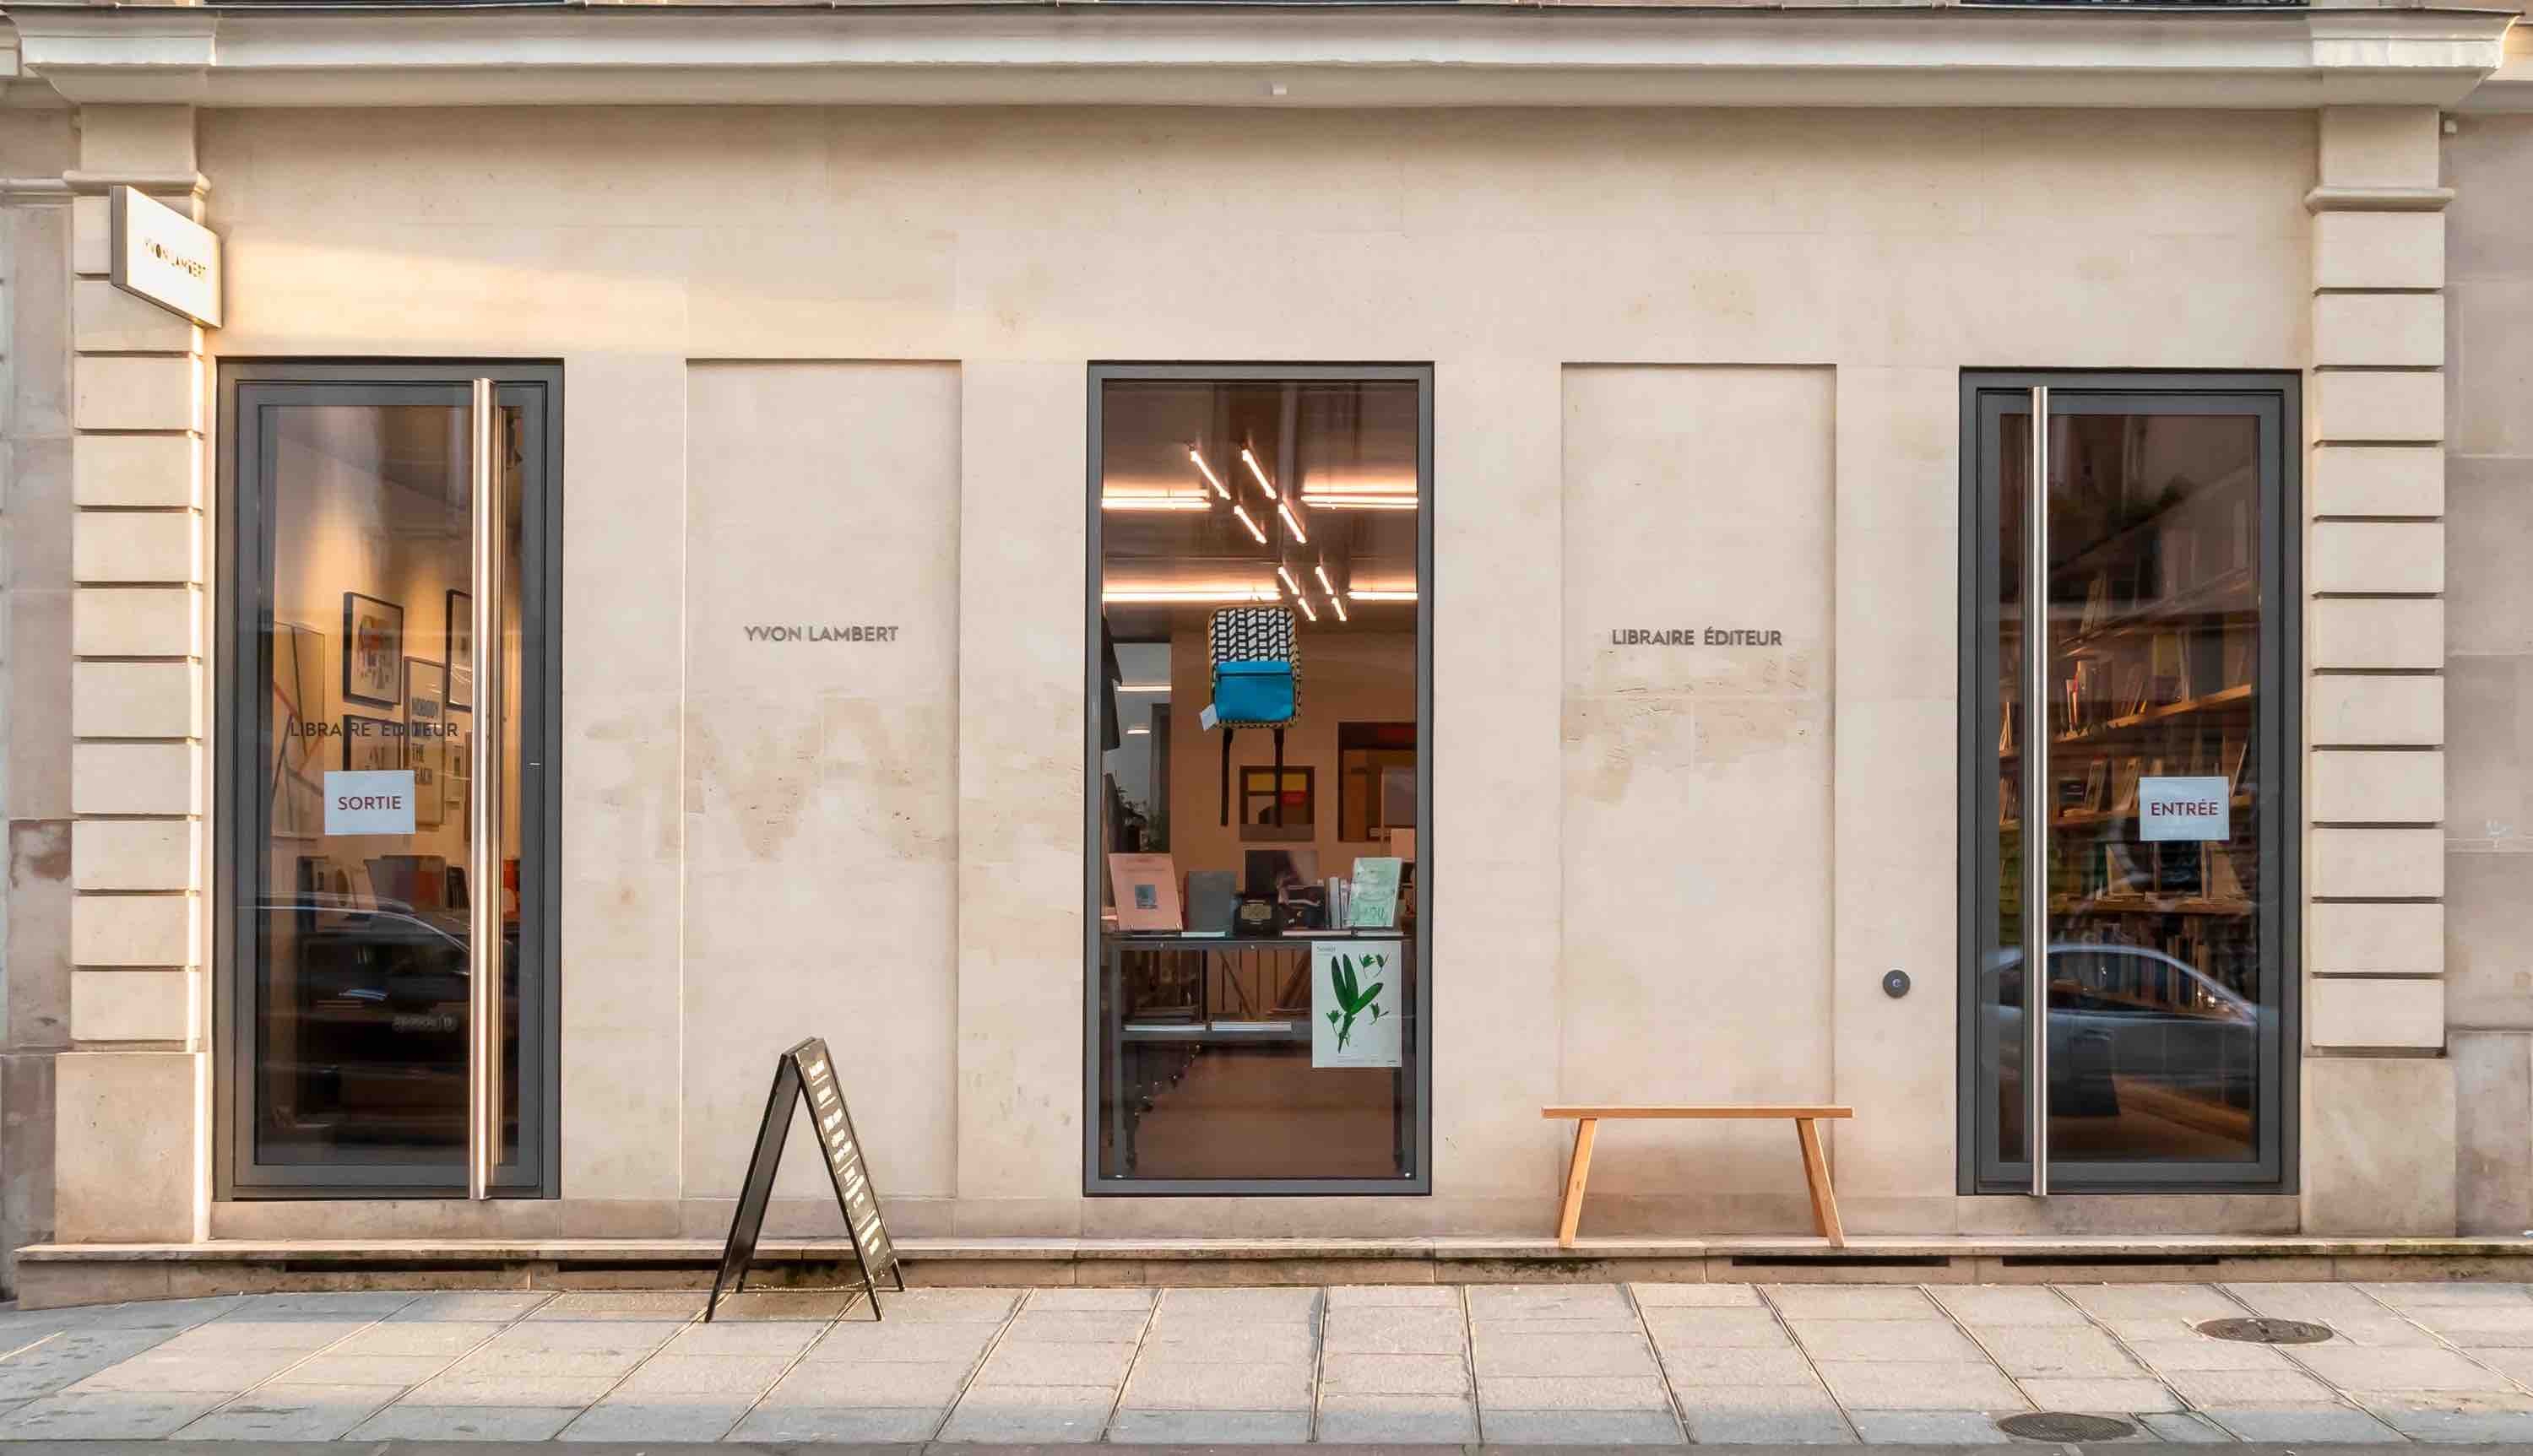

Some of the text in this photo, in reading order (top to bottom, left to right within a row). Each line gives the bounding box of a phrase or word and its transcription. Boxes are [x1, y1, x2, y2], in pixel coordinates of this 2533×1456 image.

[744, 625, 898, 641] YVON LAMBERT
[1612, 626, 1782, 646] LIBRAIRE ÉDITEUR
[290, 722, 372, 737] LIBRARE
[338, 796, 402, 810] SORTIE
[2151, 798, 2218, 816] ENTRÉE
